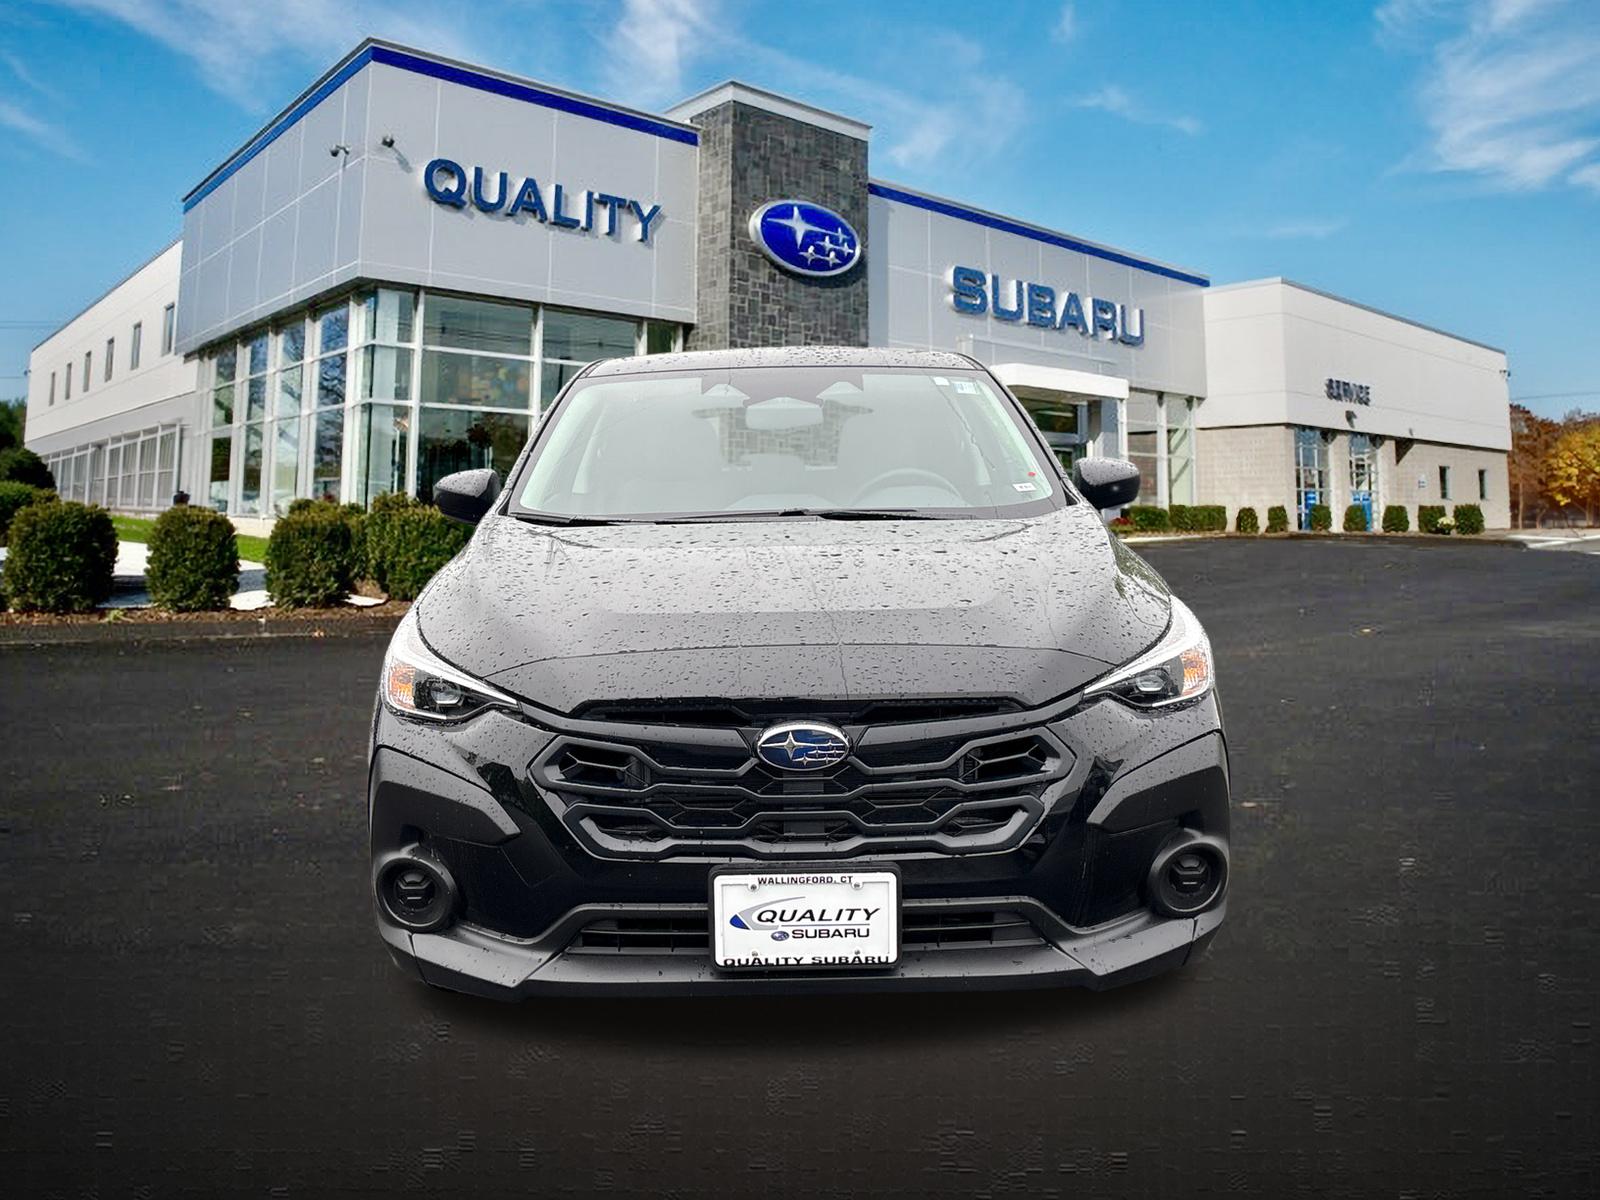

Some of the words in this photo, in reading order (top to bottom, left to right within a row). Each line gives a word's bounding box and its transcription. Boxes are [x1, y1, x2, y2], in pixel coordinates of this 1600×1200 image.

[424, 158, 662, 242] QUALITY
[950, 265, 1145, 346] SUBARU
[840, 876, 853, 884] CT
[757, 908, 880, 923] QUALITY
[792, 928, 870, 939] SUBARU
[724, 956, 804, 966] QUALITY
[811, 956, 889, 964] SUBARU
